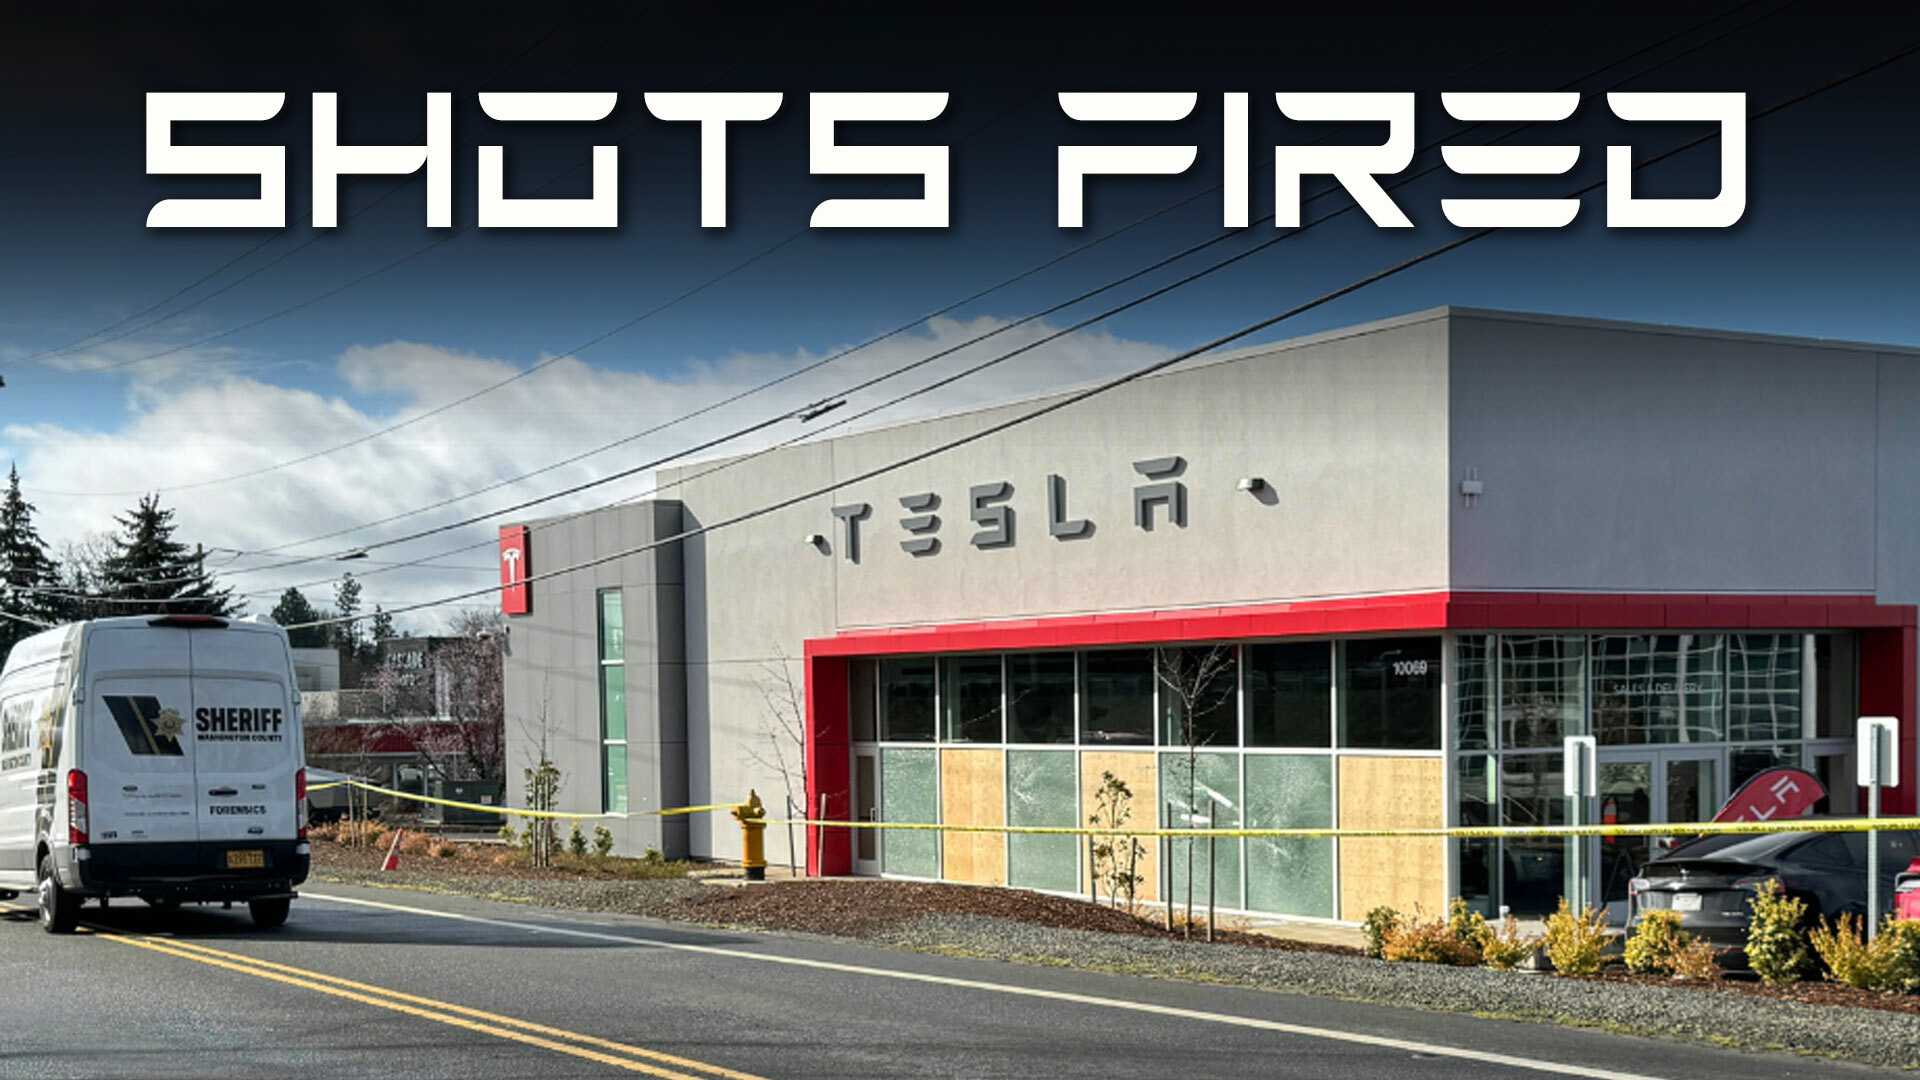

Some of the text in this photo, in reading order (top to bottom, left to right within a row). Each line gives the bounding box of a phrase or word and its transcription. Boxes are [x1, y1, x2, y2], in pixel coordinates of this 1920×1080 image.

[831, 456, 1187, 564] TESLA
[1393, 660, 1427, 676] 10069
[1654, 682, 1704, 694] DELERY
[195, 707, 282, 733] SHERIFF
[209, 805, 267, 816] FORENSICS
